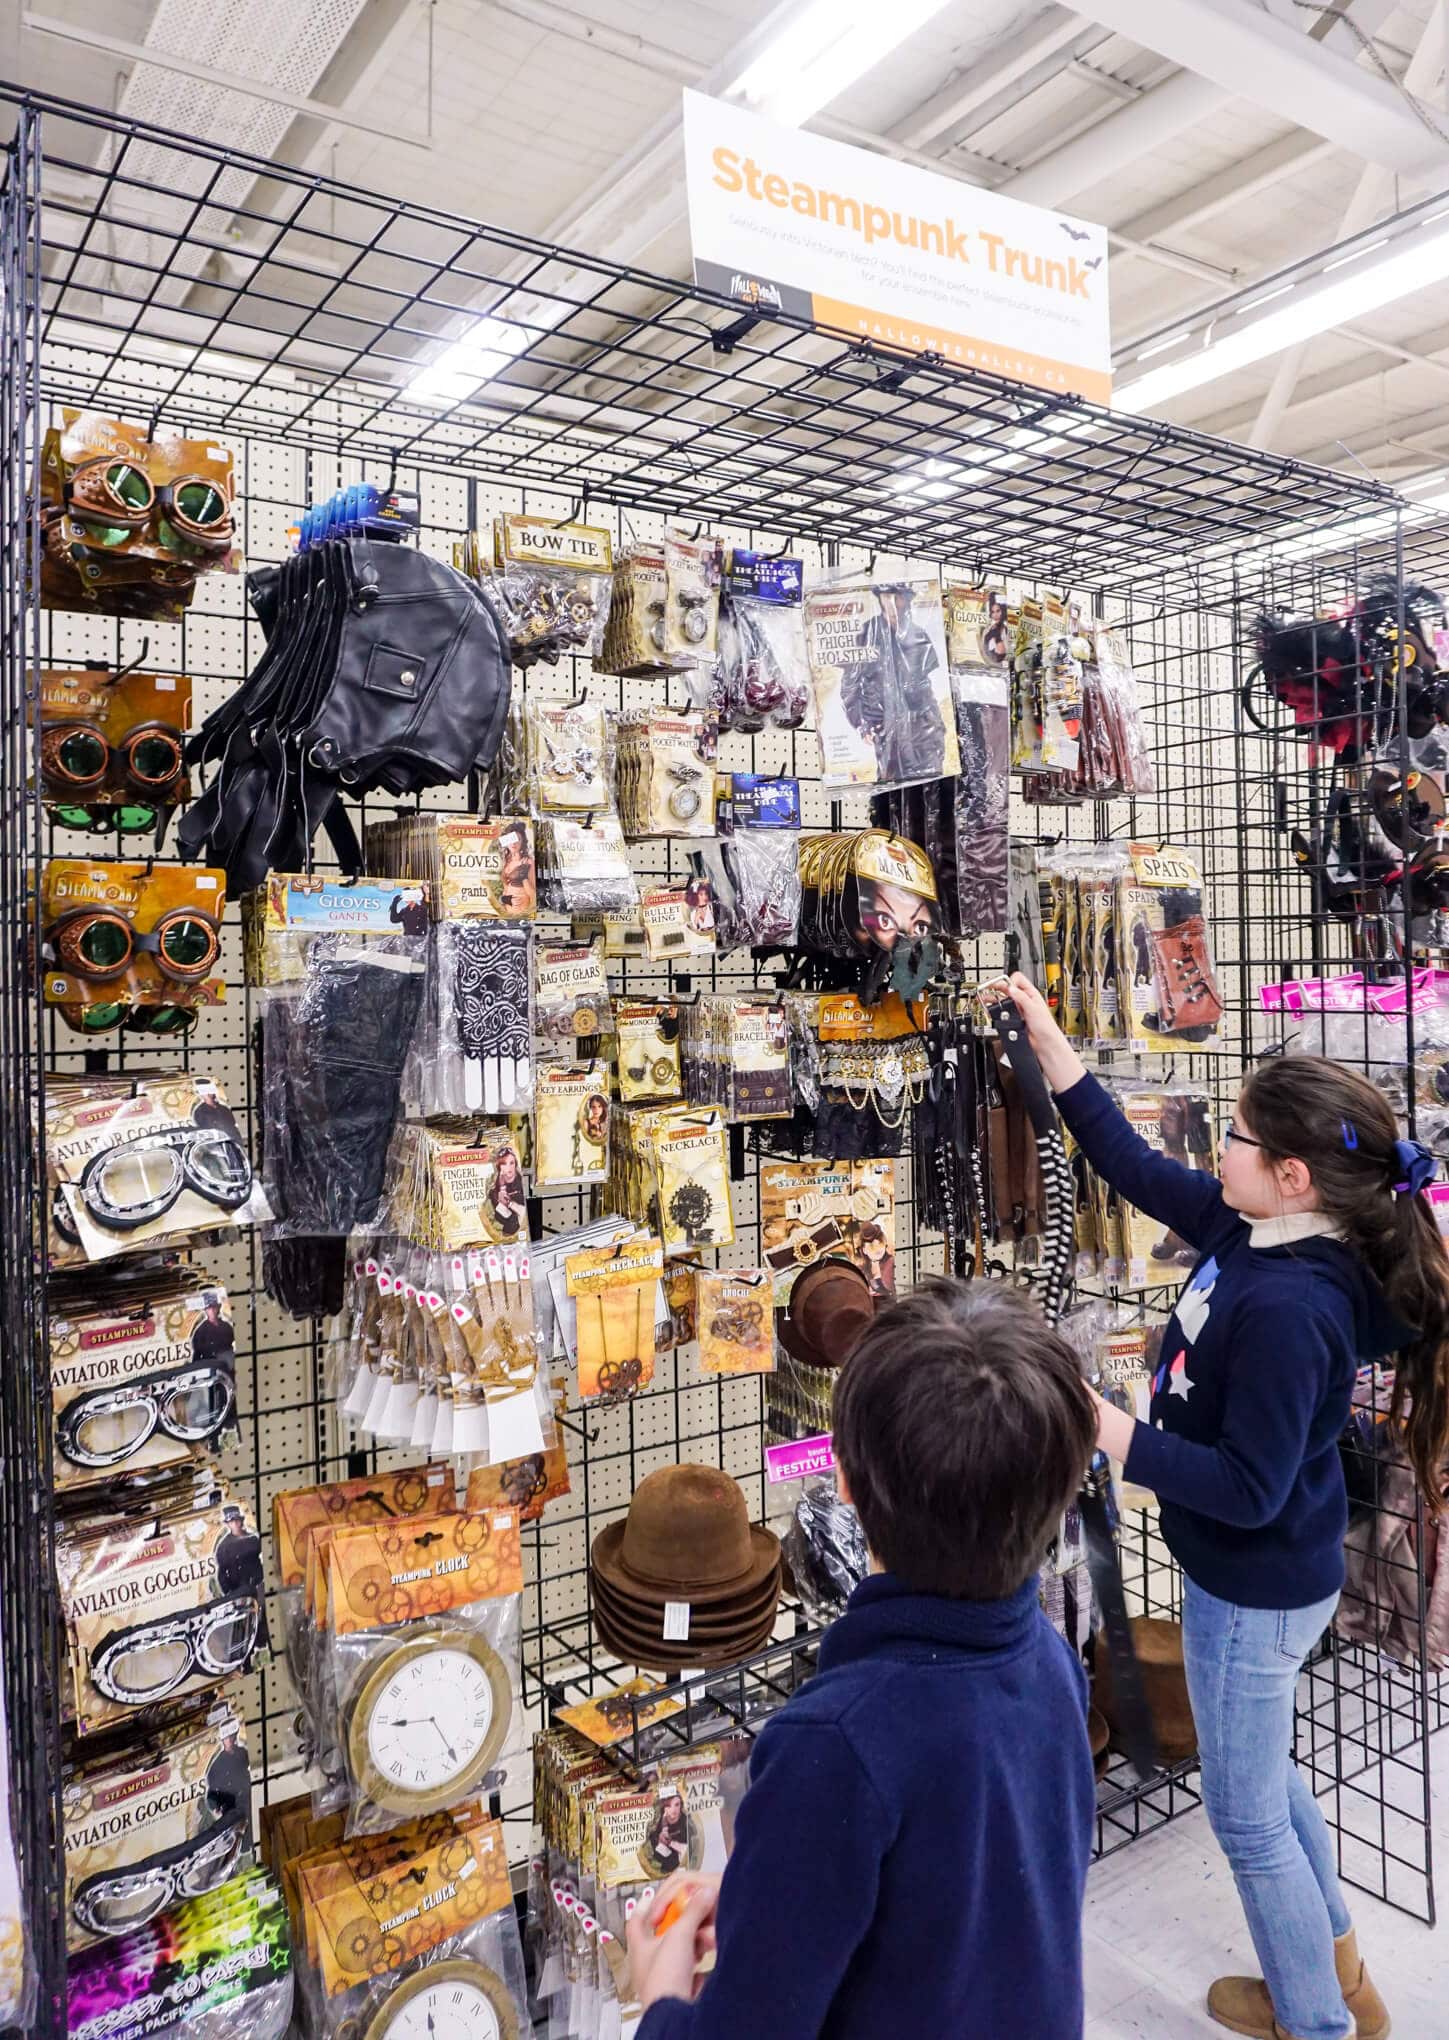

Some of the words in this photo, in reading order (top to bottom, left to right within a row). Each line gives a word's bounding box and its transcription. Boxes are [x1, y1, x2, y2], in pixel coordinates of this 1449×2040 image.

[712, 146, 969, 265] Steampunk
[978, 229, 1090, 299] Trunk
[520, 531, 563, 551] BOW
[567, 539, 599, 557] TIE
[955, 610, 986, 625] GLOVES
[816, 619, 861, 636] DOUBLE
[817, 635, 855, 650] THIGH
[817, 648, 880, 665] HOLSTERS
[448, 854, 499, 868] GLOVES
[878, 854, 914, 883] MASK
[1143, 858, 1189, 879] SPATS
[461, 886, 488, 901] gants
[1128, 890, 1156, 905] SPATS
[318, 894, 381, 911] GLOVES
[328, 909, 370, 923] GANTS
[578, 914, 600, 924] RING
[609, 914, 632, 922] RING
[644, 905, 681, 918] BULLET
[651, 913, 676, 924] RING
[540, 971, 558, 985] BAG
[559, 969, 571, 982] OF
[572, 965, 601, 981] GEARS
[734, 1031, 776, 1042] BRACELET
[540, 1086, 556, 1094] KEY
[558, 1083, 599, 1094] EARRINGS
[57, 1131, 123, 1161] AVIATOR
[660, 1135, 720, 1154] NECKLACE
[450, 1177, 486, 1192] FISHNET
[777, 1174, 851, 1188] STEAMPUNK
[453, 1188, 486, 1202] GLOVES
[822, 1185, 844, 1195] KIT
[609, 1255, 655, 1274] NECKLACE
[90, 1324, 146, 1345] STEAMPUNK
[51, 1358, 121, 1388] AVIATOR
[122, 1341, 192, 1374] GOGGLES
[1104, 1356, 1146, 1371] SPATS
[775, 1455, 830, 1477] FESTIVE
[390, 1567, 433, 1585] STEAMPUNK
[434, 1554, 470, 1577] CLOCK
[71, 1581, 143, 1619] AVIATOR
[143, 1556, 217, 1595] GOGGLES
[103, 1772, 162, 1802] STEAMPUNK
[687, 1780, 718, 1799] ATS
[609, 1798, 648, 1810] STEAMPUNK
[63, 1811, 133, 1853] AVIATOR
[134, 1778, 207, 1822] GOGGLES
[603, 1808, 654, 1826] FINGERLESS
[610, 1821, 646, 1835] FISHNET
[612, 1831, 645, 1846] GLOVES
[379, 1906, 421, 1935] STEAMPUNK
[421, 1882, 458, 1912] CLOCK
[145, 2002, 191, 2034] PACIFIC
